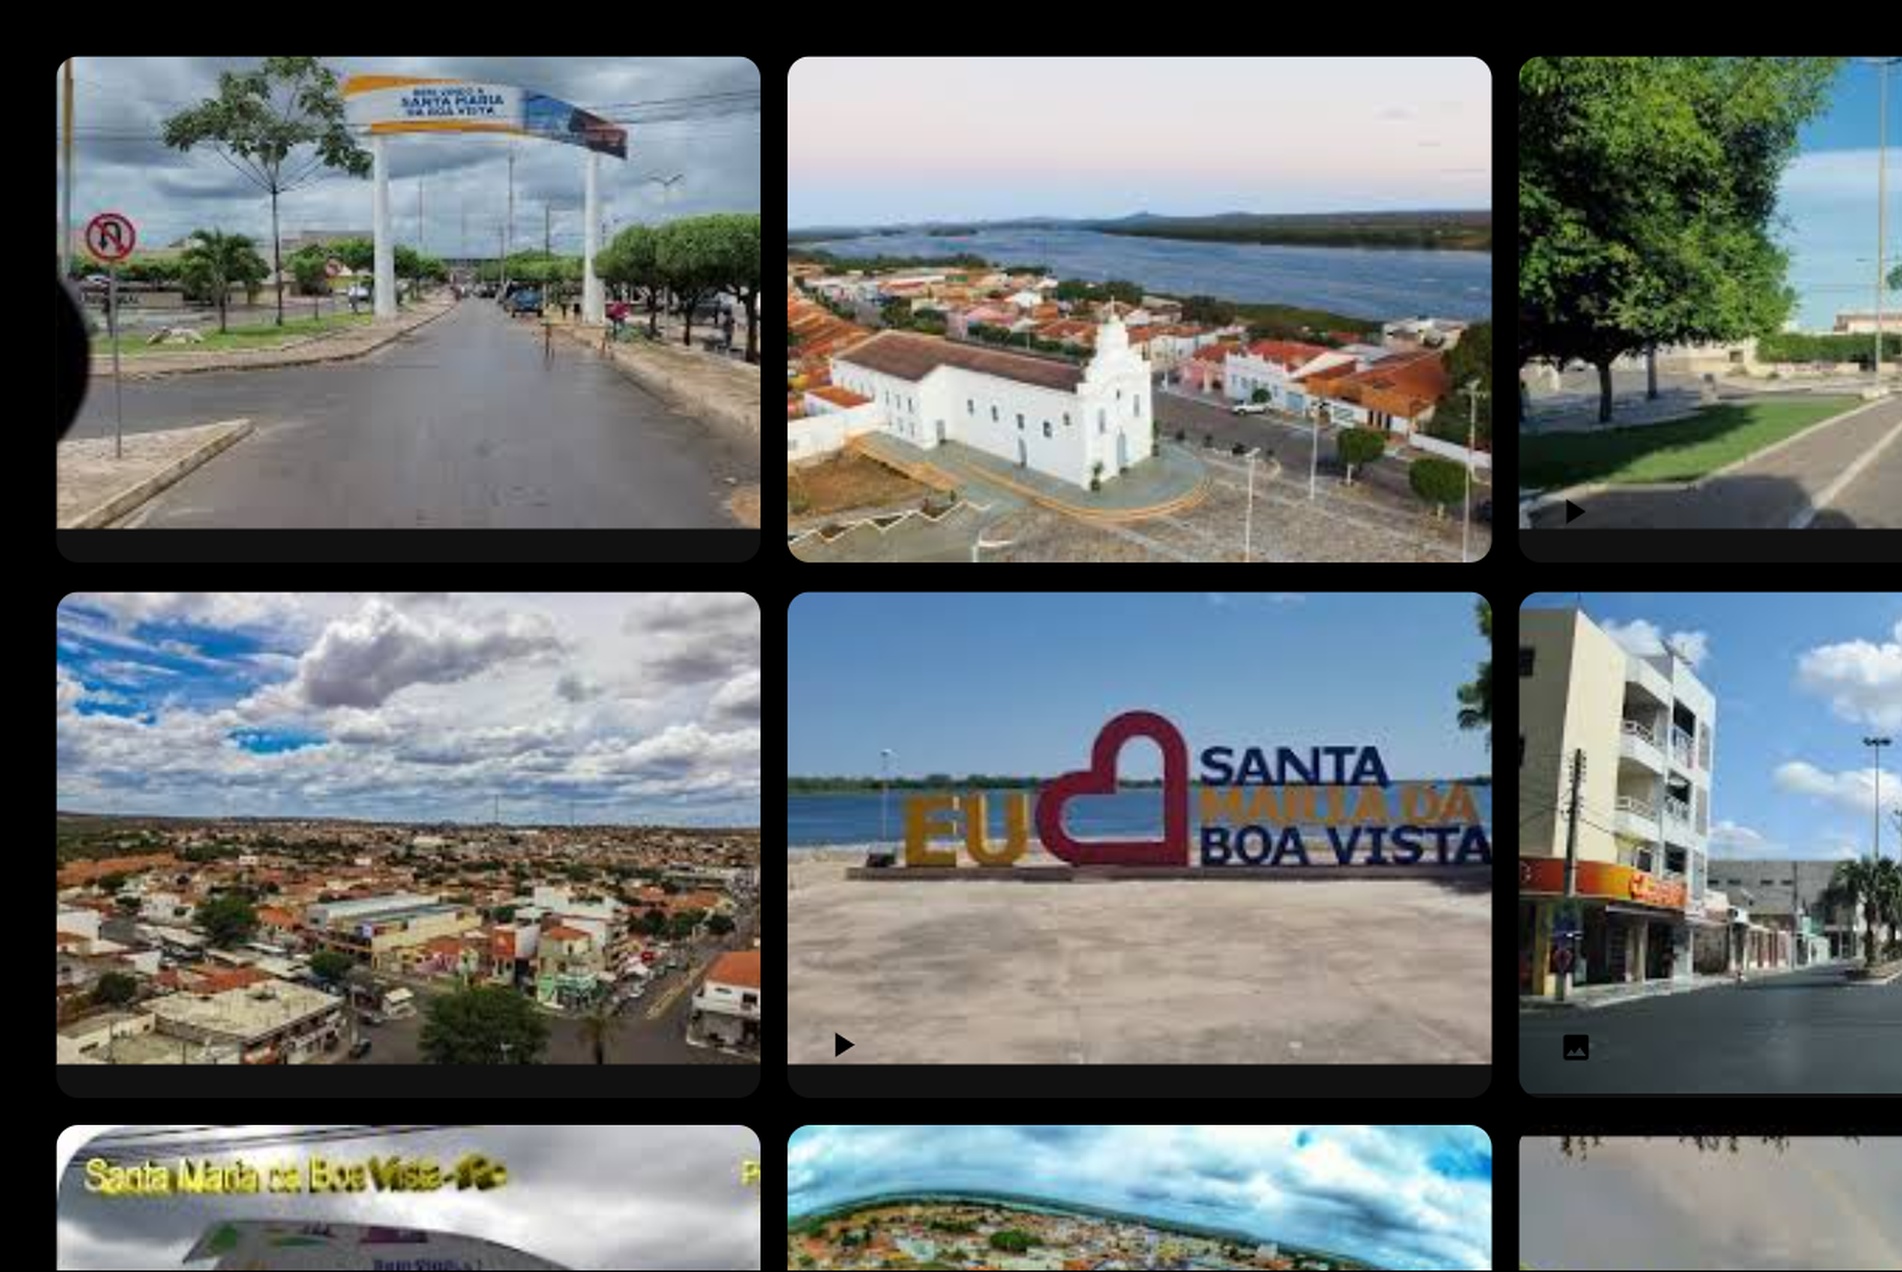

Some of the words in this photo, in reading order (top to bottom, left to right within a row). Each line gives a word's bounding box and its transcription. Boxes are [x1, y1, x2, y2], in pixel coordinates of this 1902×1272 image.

[401, 97, 451, 107] SANTA
[455, 94, 504, 105] MARIA
[1200, 745, 1389, 787] SANTA
[1200, 784, 1391, 825] MARIA
[1401, 783, 1481, 825] DA
[905, 793, 1028, 867] EU
[1201, 825, 1311, 866] BOA
[1326, 825, 1491, 866] VISTA
